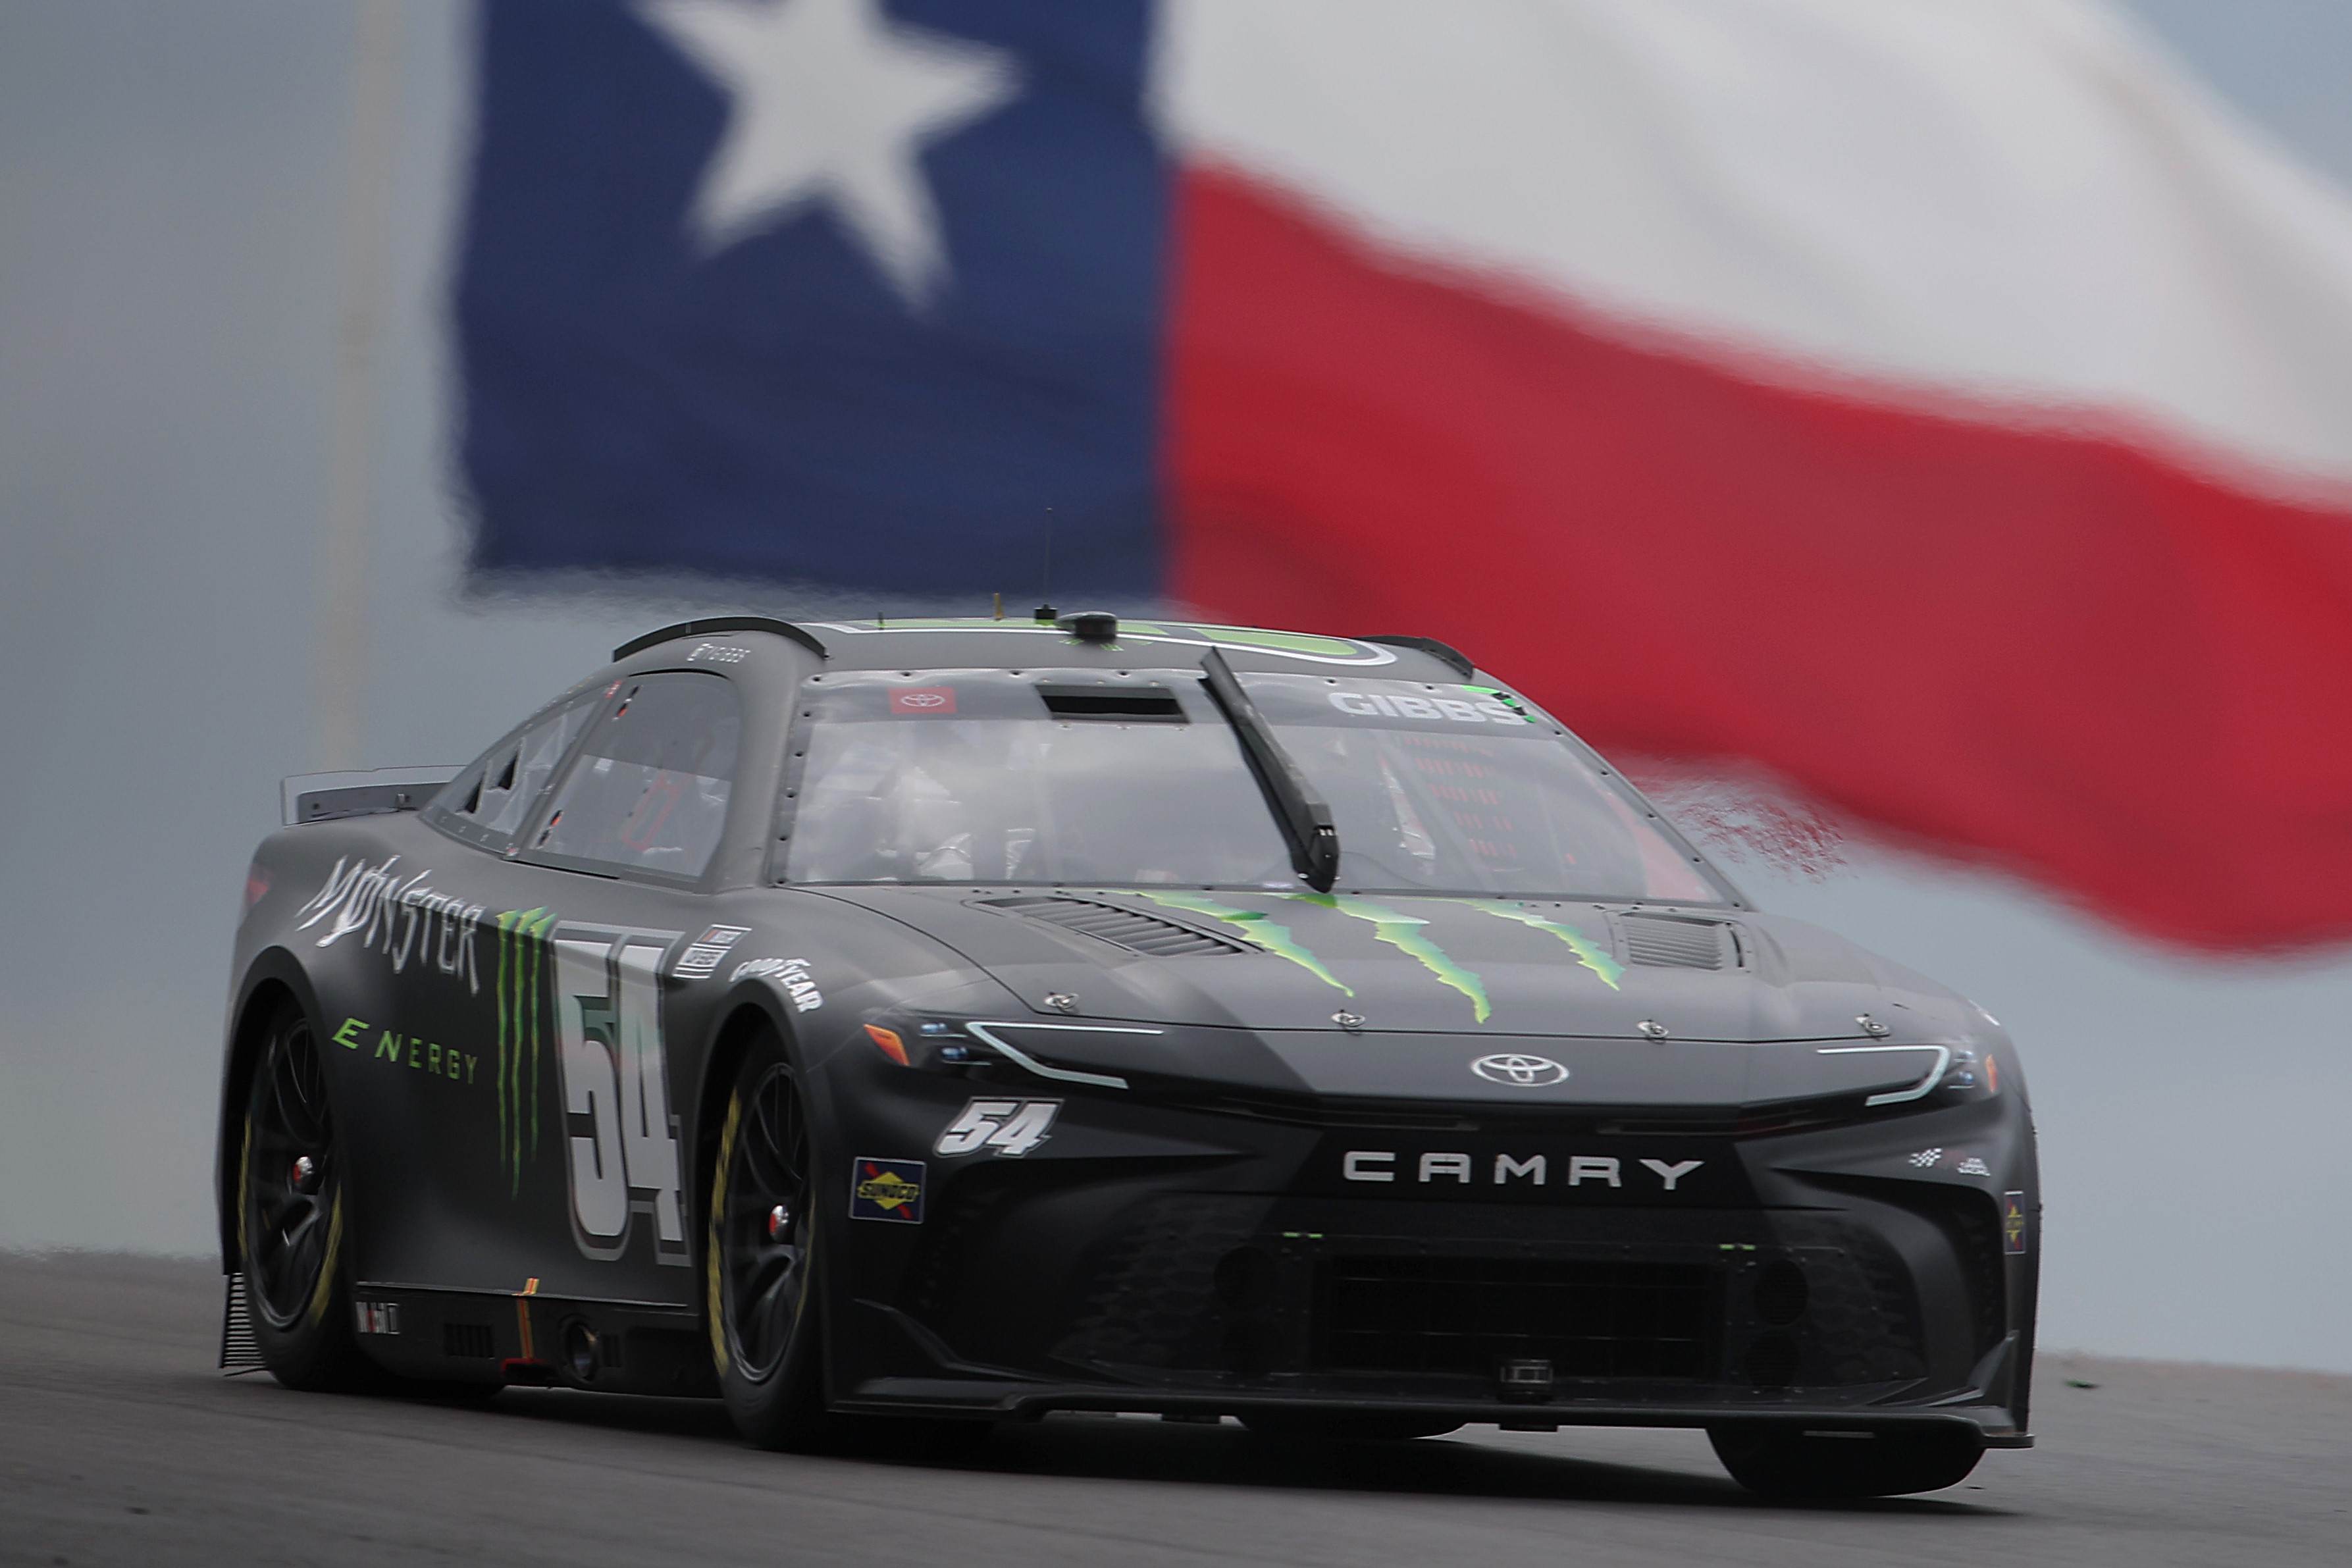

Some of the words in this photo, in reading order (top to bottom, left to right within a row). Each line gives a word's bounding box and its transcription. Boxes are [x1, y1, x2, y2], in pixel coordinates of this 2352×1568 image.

[1328, 692, 1530, 725] GIBBS
[294, 855, 487, 995] MONSTER
[332, 1017, 478, 1084] ENERGY
[549, 921, 692, 1266] 54
[933, 1095, 1064, 1158] 54
[860, 1182, 917, 1201] SUNOCO
[1344, 1151, 1705, 1190] CAMRY
